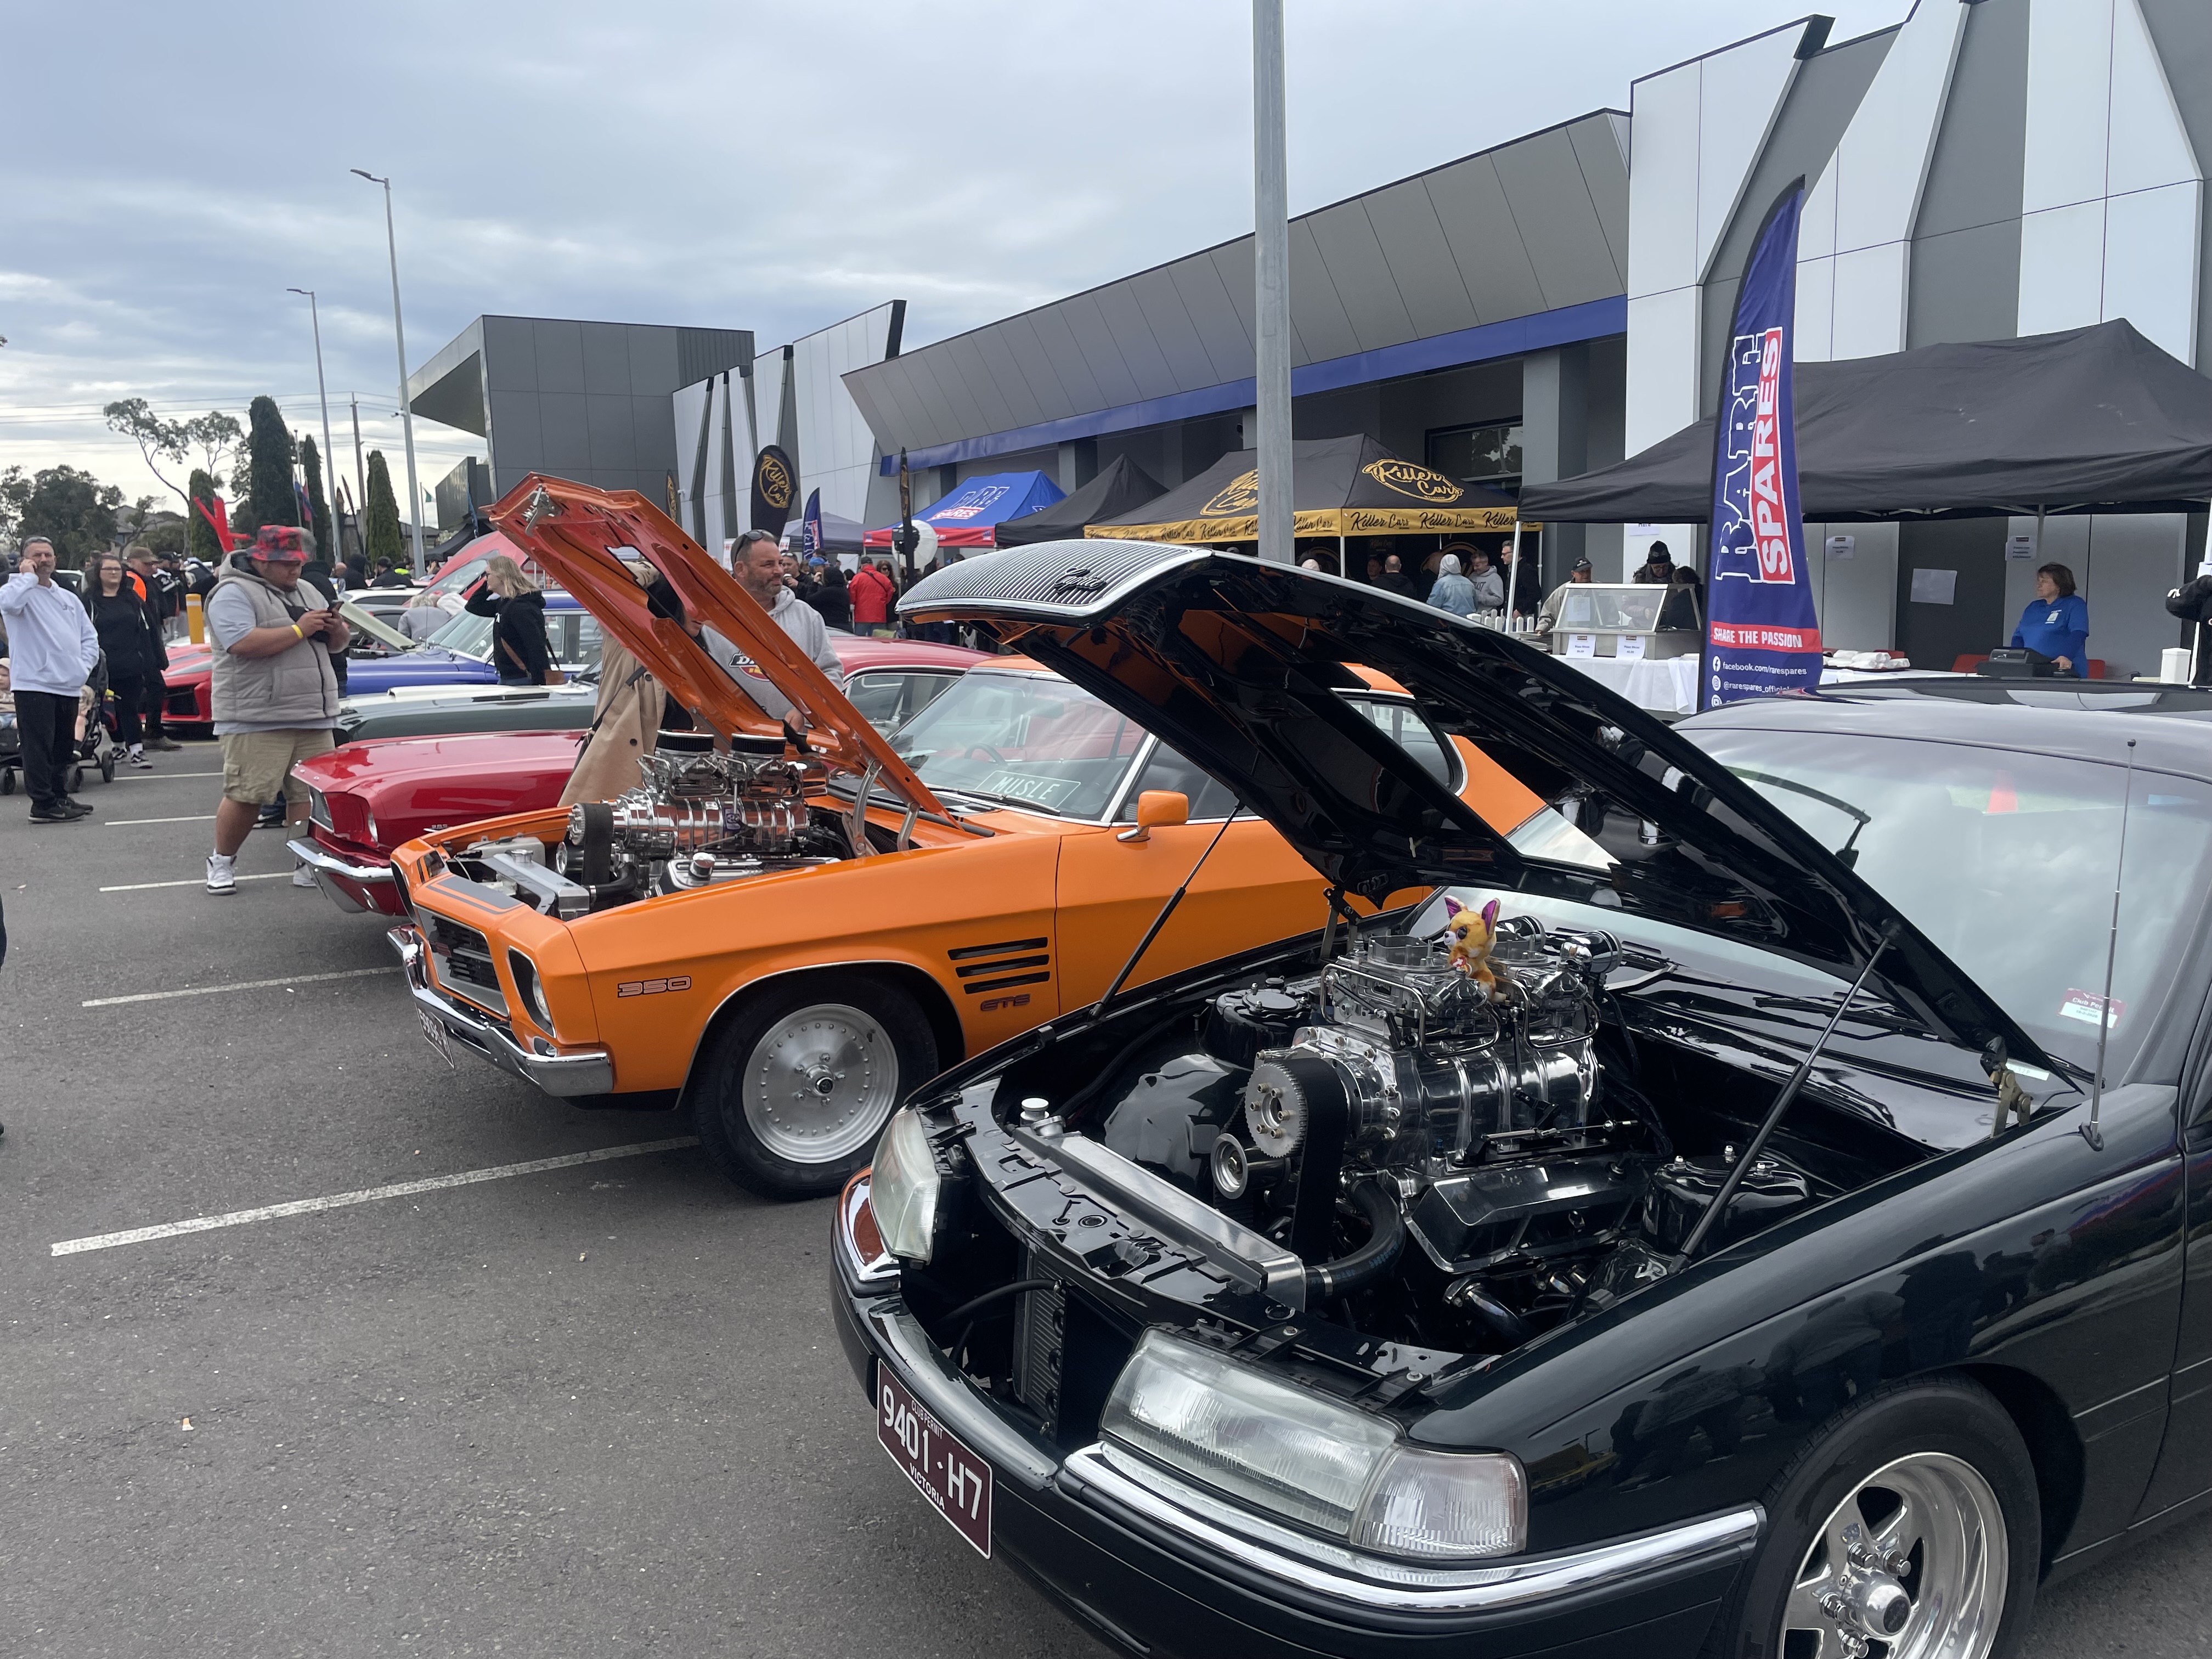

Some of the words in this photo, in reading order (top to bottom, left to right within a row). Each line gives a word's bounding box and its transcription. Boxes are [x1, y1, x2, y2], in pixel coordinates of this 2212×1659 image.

[1716, 332, 1768, 584] RARE
[1754, 336, 1791, 576] SPARES
[1368, 464, 1445, 483] Killer
[1417, 481, 1464, 496] Cars
[1351, 511, 1387, 531] Killer
[1389, 514, 1409, 528] Cars
[1419, 512, 1454, 529] Killer
[1455, 514, 1475, 527] Cars
[1482, 511, 1517, 529] Killer
[1713, 628, 1735, 644] SHARE
[1738, 630, 1759, 645] THE
[1762, 631, 1803, 648] PASSION
[1723, 662, 1807, 676] facebook.com/rarespares
[990, 776, 1061, 800] MUSLE
[617, 975, 692, 998] 350
[980, 994, 1030, 1011] GTS
[2072, 997, 2089, 1006] Club
[2090, 1002, 2115, 1013] Perit
[911, 1400, 924, 1420] CLUB
[924, 1413, 943, 1440] PERMIT
[909, 1462, 945, 1510] VICTORIA
